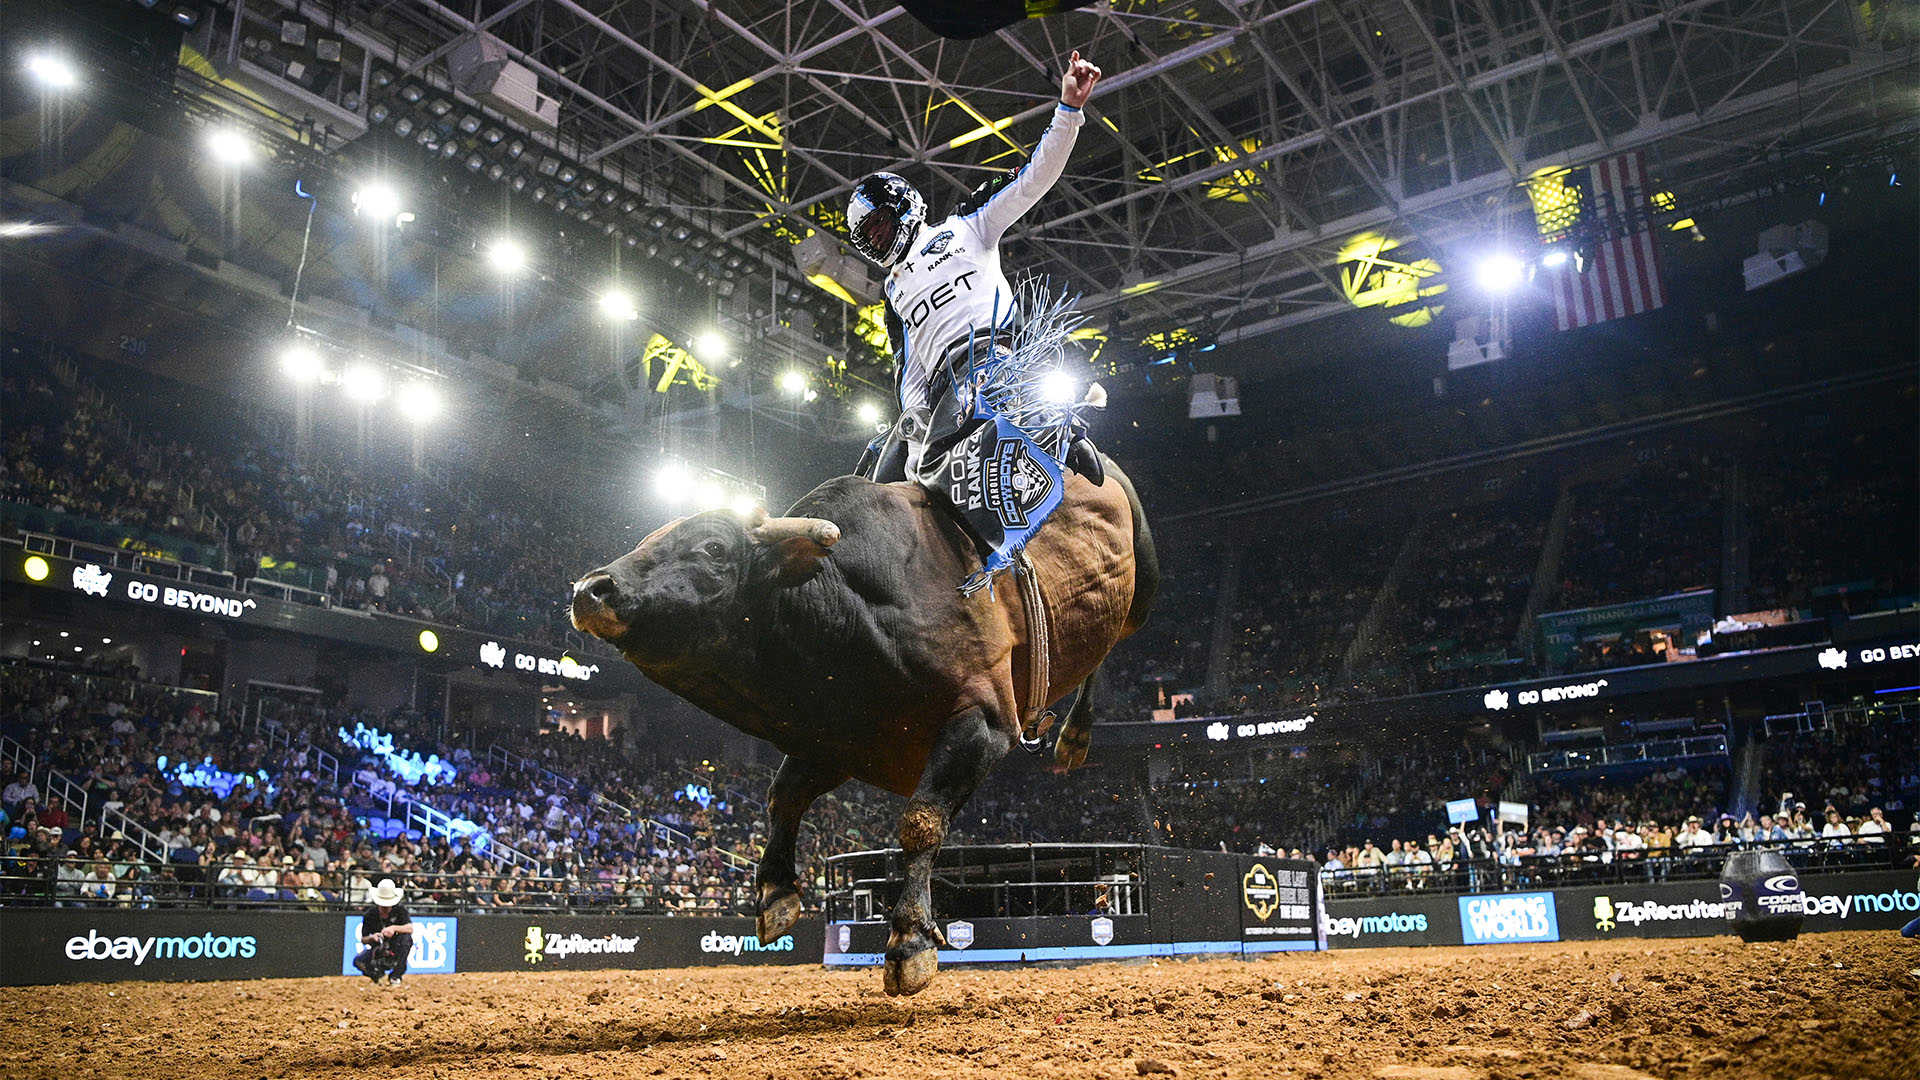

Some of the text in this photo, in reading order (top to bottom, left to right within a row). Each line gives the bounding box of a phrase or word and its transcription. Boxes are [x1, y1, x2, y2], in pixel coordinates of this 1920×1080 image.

[928, 251, 953, 272] RANK
[904, 270, 977, 331] OET
[990, 461, 1001, 506] CAROLINA
[1000, 442, 1020, 523] COWBOYS
[128, 581, 159, 602] GO
[514, 653, 536, 671] GO
[1860, 648, 1886, 663] GO
[1518, 691, 1540, 705] GO
[1237, 724, 1256, 737] GO
[1467, 896, 1546, 920] CAMPING
[1469, 911, 1550, 939] WORLD
